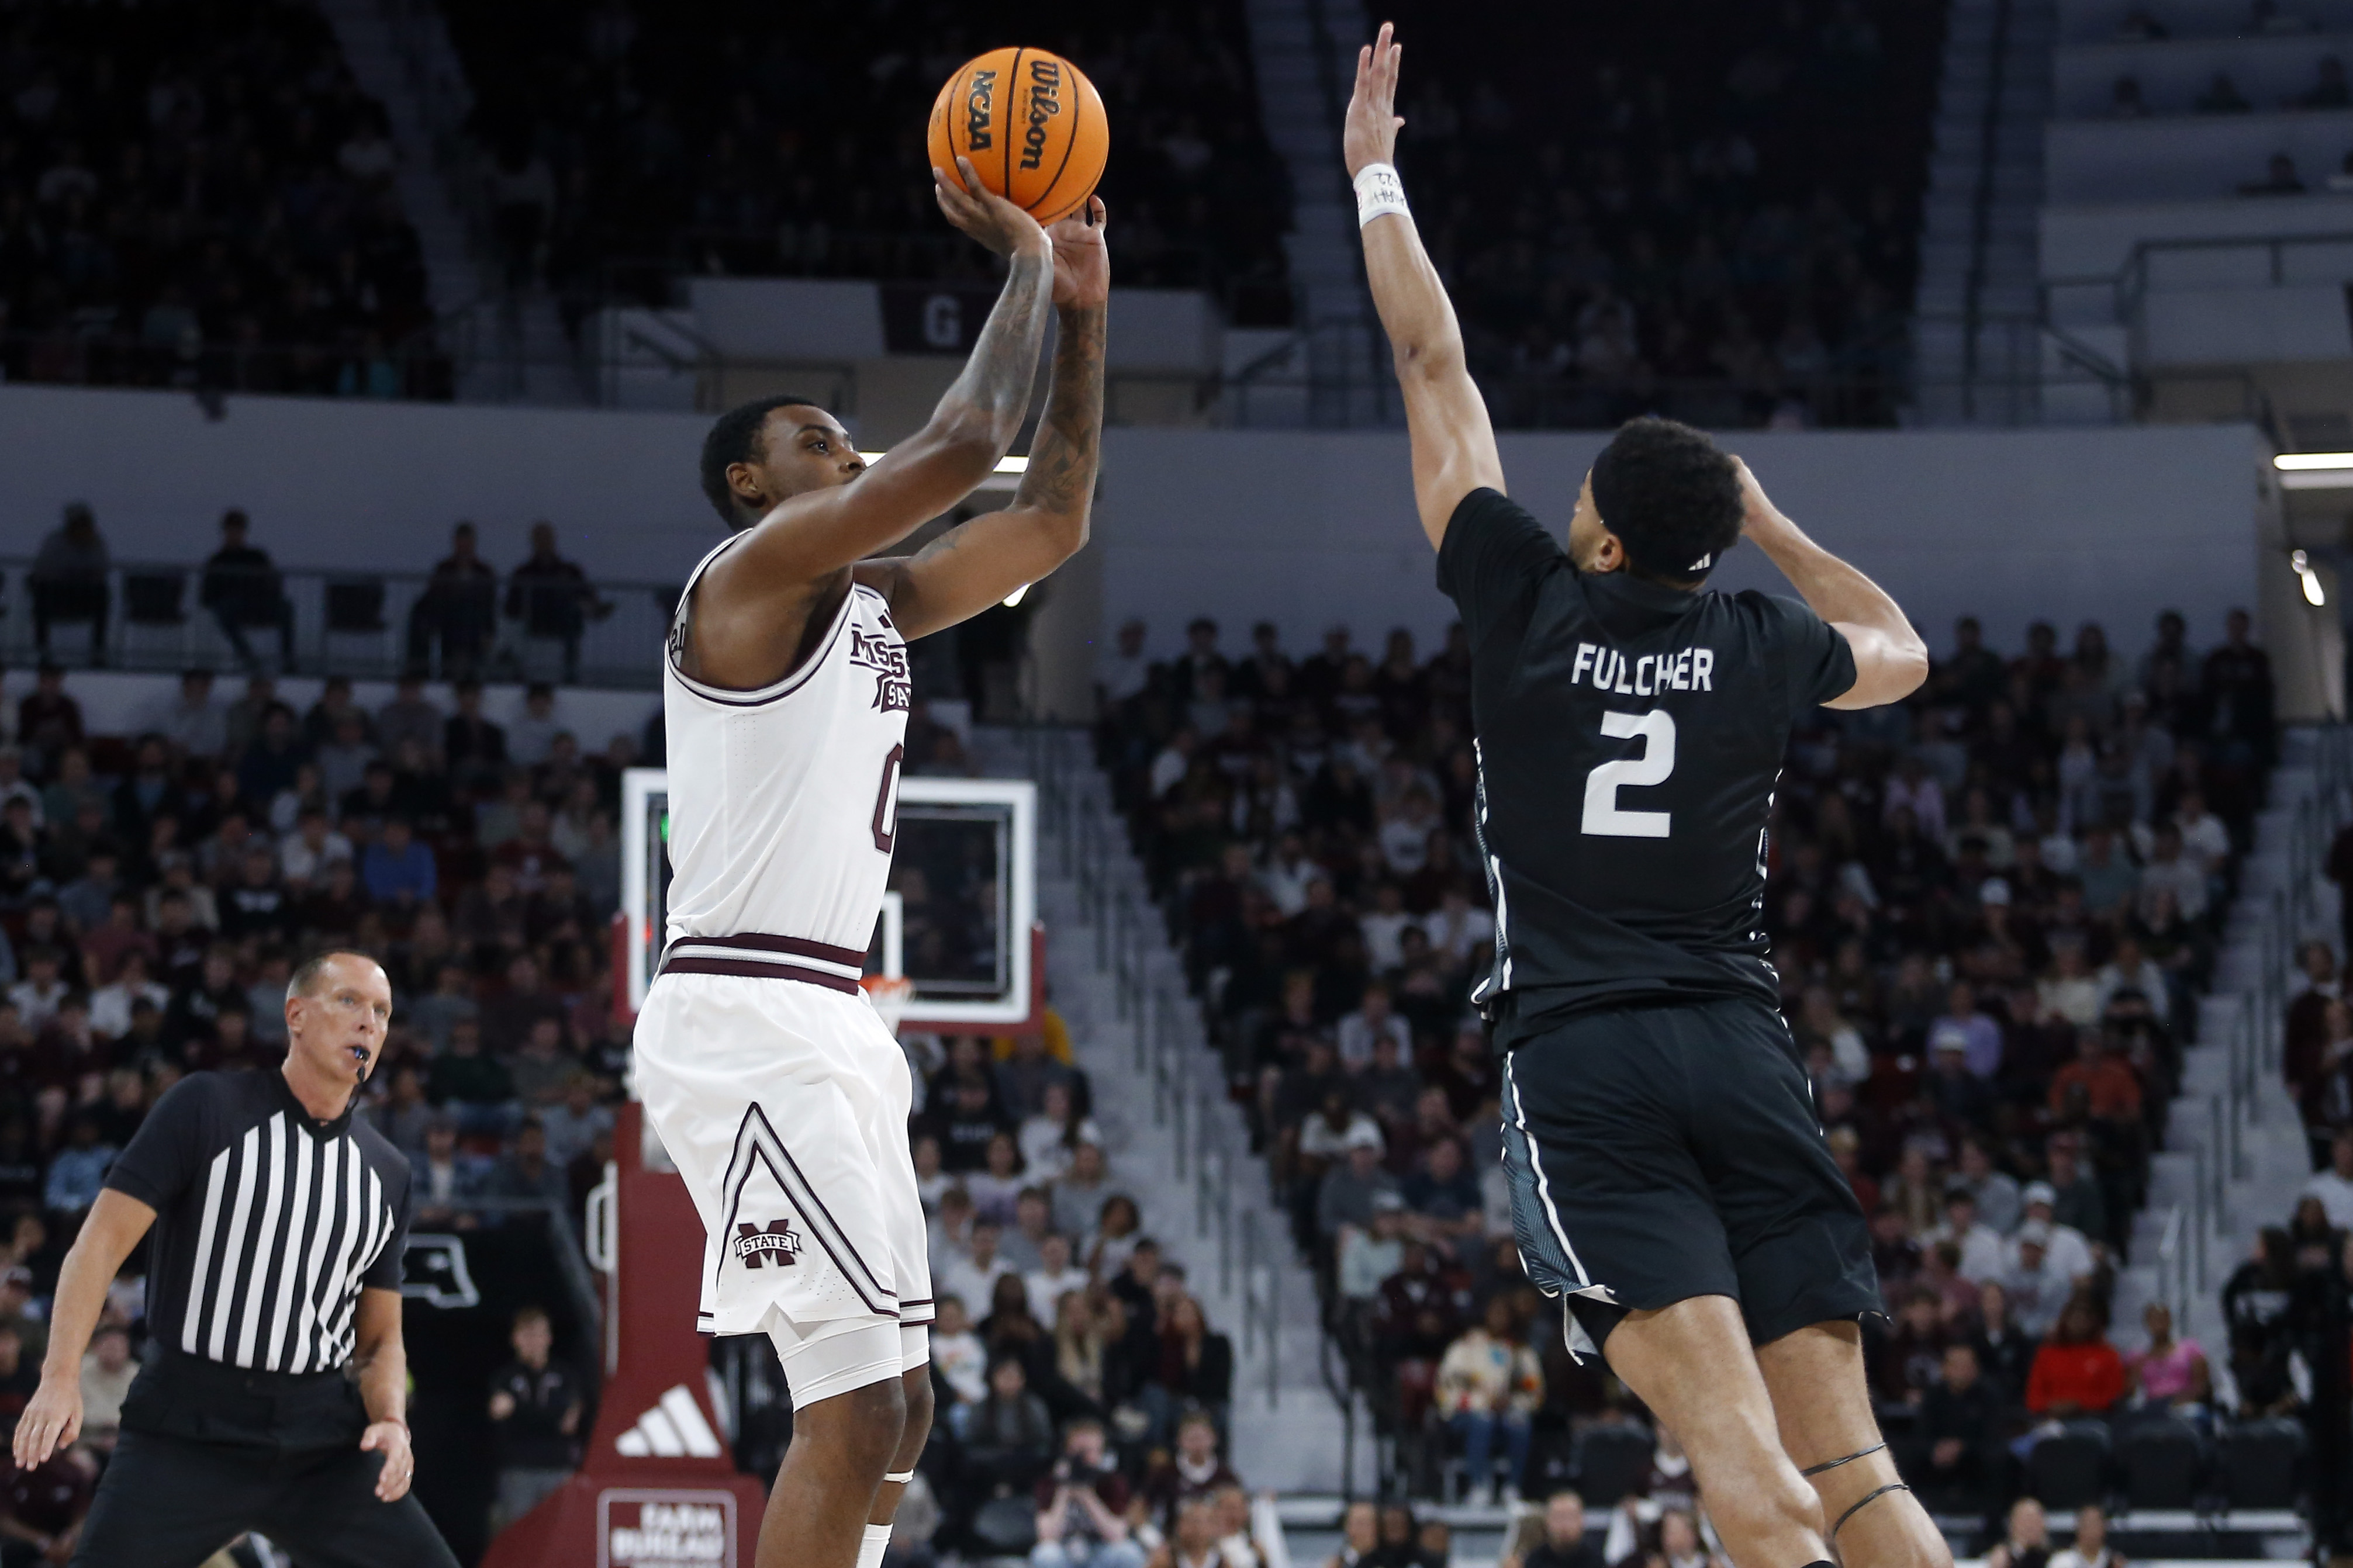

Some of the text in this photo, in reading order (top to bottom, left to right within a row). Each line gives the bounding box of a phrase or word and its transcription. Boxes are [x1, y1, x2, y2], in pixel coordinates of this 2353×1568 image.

[968, 71, 997, 152] NCAA
[1020, 61, 1060, 171] Wilson
[924, 296, 962, 345] G
[1571, 643, 1714, 696] FULCHER
[1581, 709, 1676, 838] 2
[744, 1235, 788, 1252] STATE
